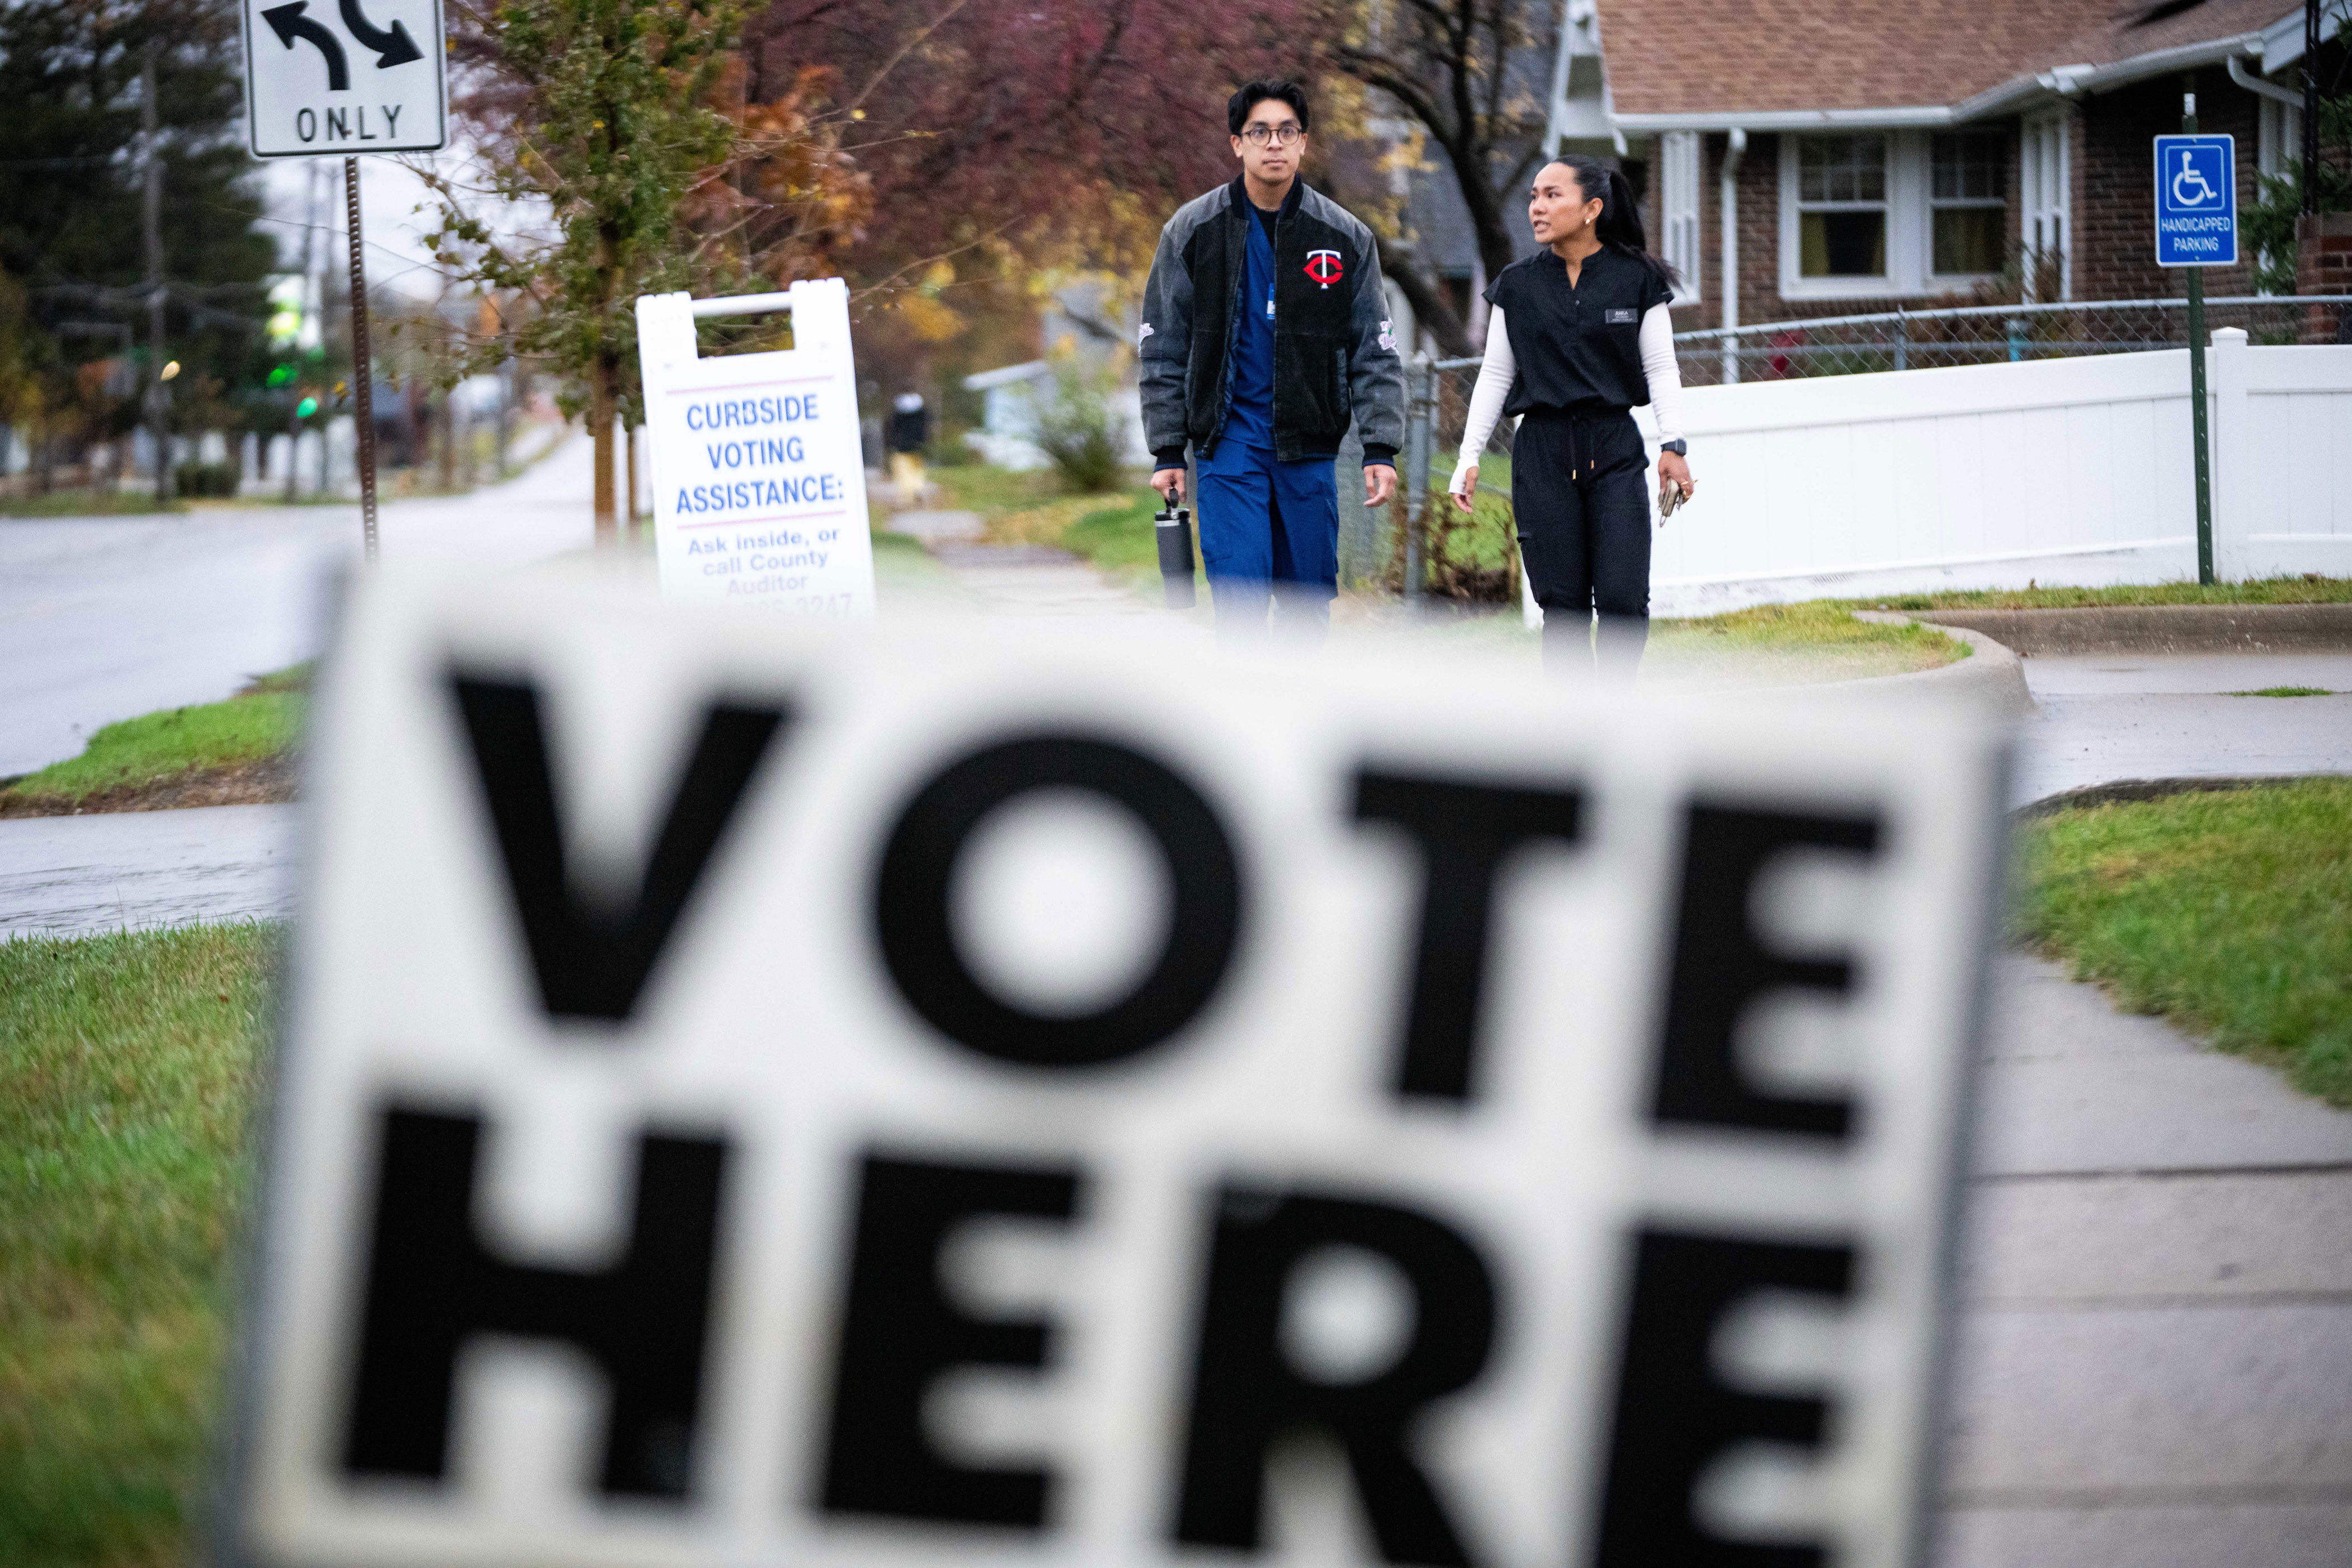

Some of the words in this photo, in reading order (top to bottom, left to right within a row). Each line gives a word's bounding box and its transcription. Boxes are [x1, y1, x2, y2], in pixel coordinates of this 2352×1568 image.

[296, 104, 403, 143] ONLY
[2161, 216, 2231, 233] HANDICAPPED
[2174, 237, 2219, 252] PARKING
[686, 393, 820, 431] CURBSIDE
[706, 435, 805, 470] VOTING
[676, 473, 844, 514] ASSISTANCE:
[687, 536, 728, 556] Ask
[736, 529, 810, 551] inside,
[818, 528, 841, 544] or
[702, 558, 742, 577] call
[750, 550, 829, 571] County
[728, 574, 809, 596] Auditor
[442, 662, 1892, 1155] VOTE
[321, 1092, 1872, 1568] HERE
